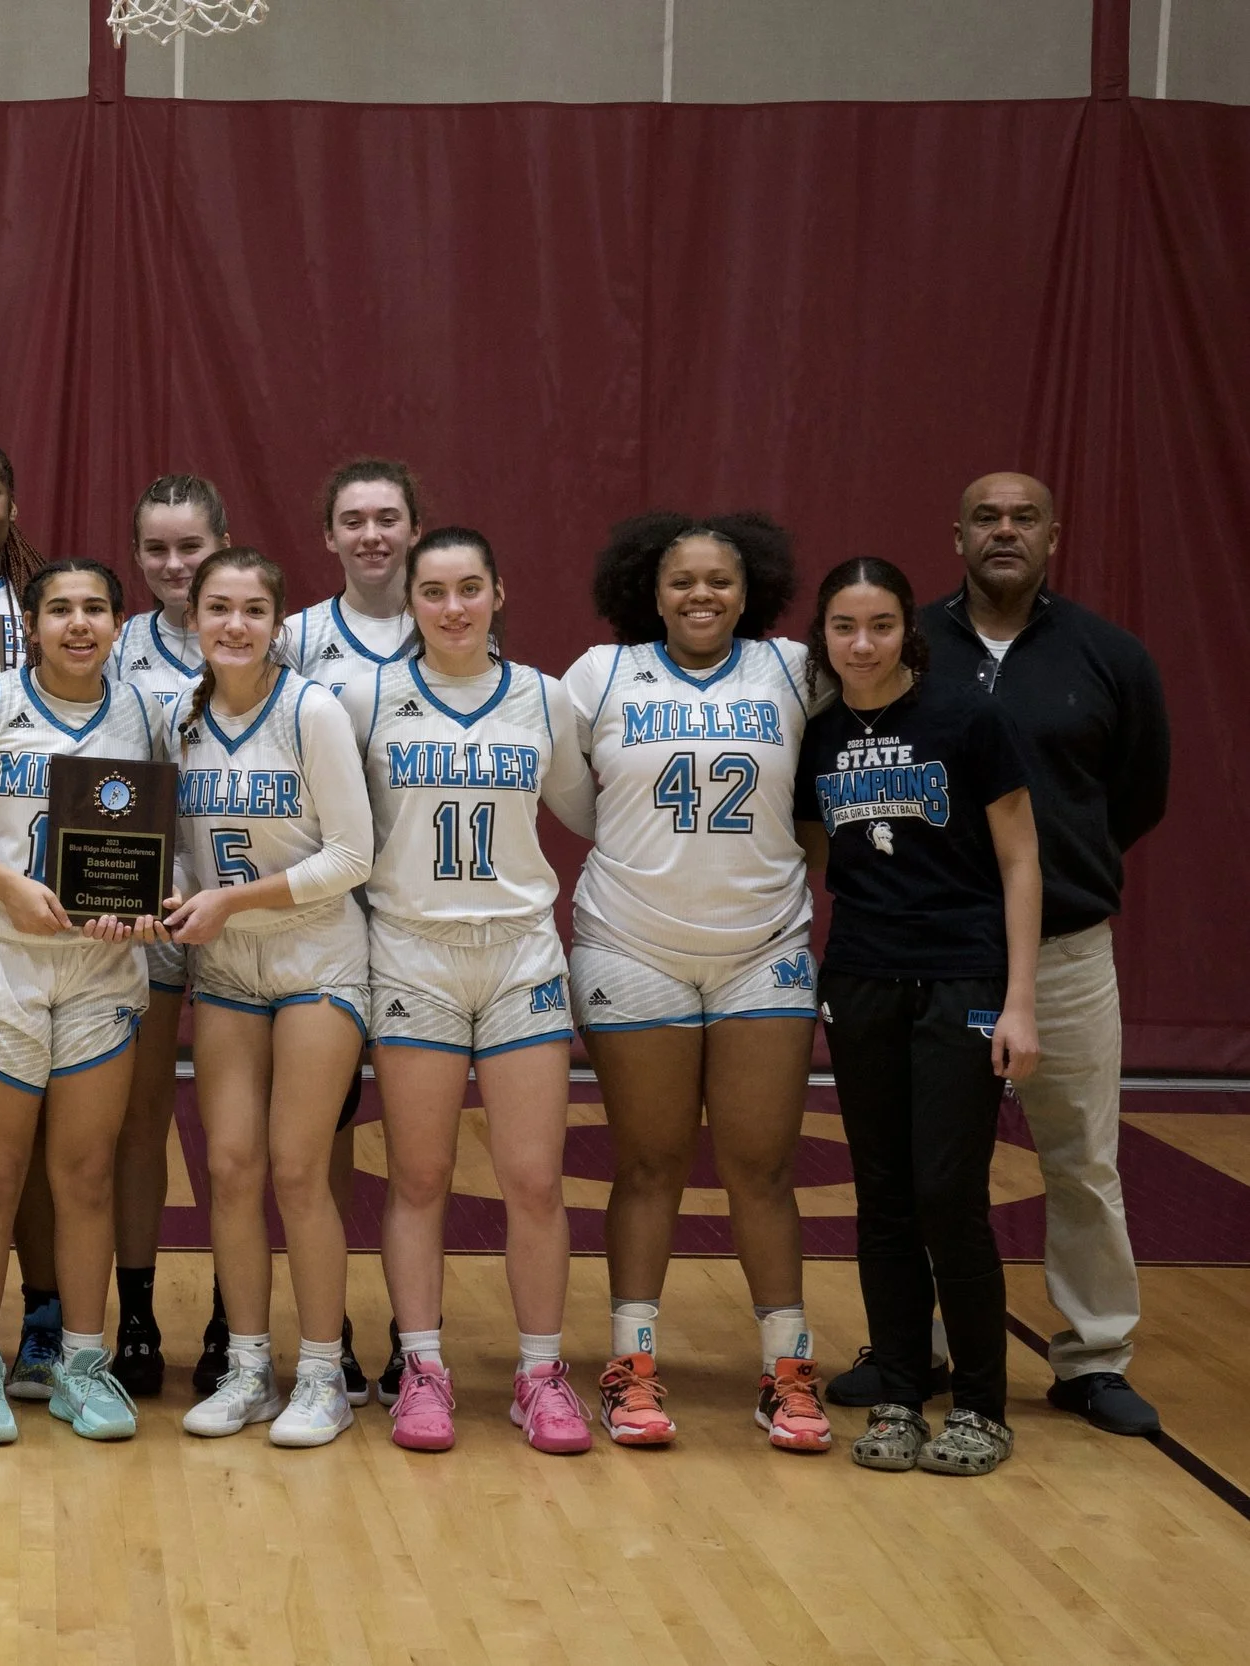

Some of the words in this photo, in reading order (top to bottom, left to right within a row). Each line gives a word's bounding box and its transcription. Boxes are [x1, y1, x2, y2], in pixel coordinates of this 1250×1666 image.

[320, 652, 345, 660] adidas
[395, 710, 424, 718] adidas
[8, 721, 35, 730] adidas
[622, 699, 785, 748] MILLER
[847, 739, 864, 750] 2022
[877, 736, 901, 746] VISAA
[386, 740, 540, 793] MILLER
[836, 744, 914, 771] STATE
[177, 768, 303, 818] MILLER
[653, 751, 760, 835] 42
[815, 760, 951, 838] CHAMPIONS
[834, 808, 850, 822] MSA
[851, 805, 871, 818] GIRLS
[872, 804, 922, 816] BASKETBALL
[69, 843, 82, 851] Blue
[82, 844, 100, 854] Ridge
[100, 846, 122, 854] Athletic
[122, 847, 156, 856] Conference
[105, 838, 120, 846] 2023
[432, 800, 499, 882] 11
[86, 857, 137, 869] Basketball
[209, 828, 261, 888] 5
[82, 868, 139, 881] Tournament
[75, 892, 143, 910] Champion
[770, 951, 814, 990] M
[530, 974, 566, 1014] M
[385, 1010, 411, 1018] adidas
[969, 1011, 1000, 1024] MILL
